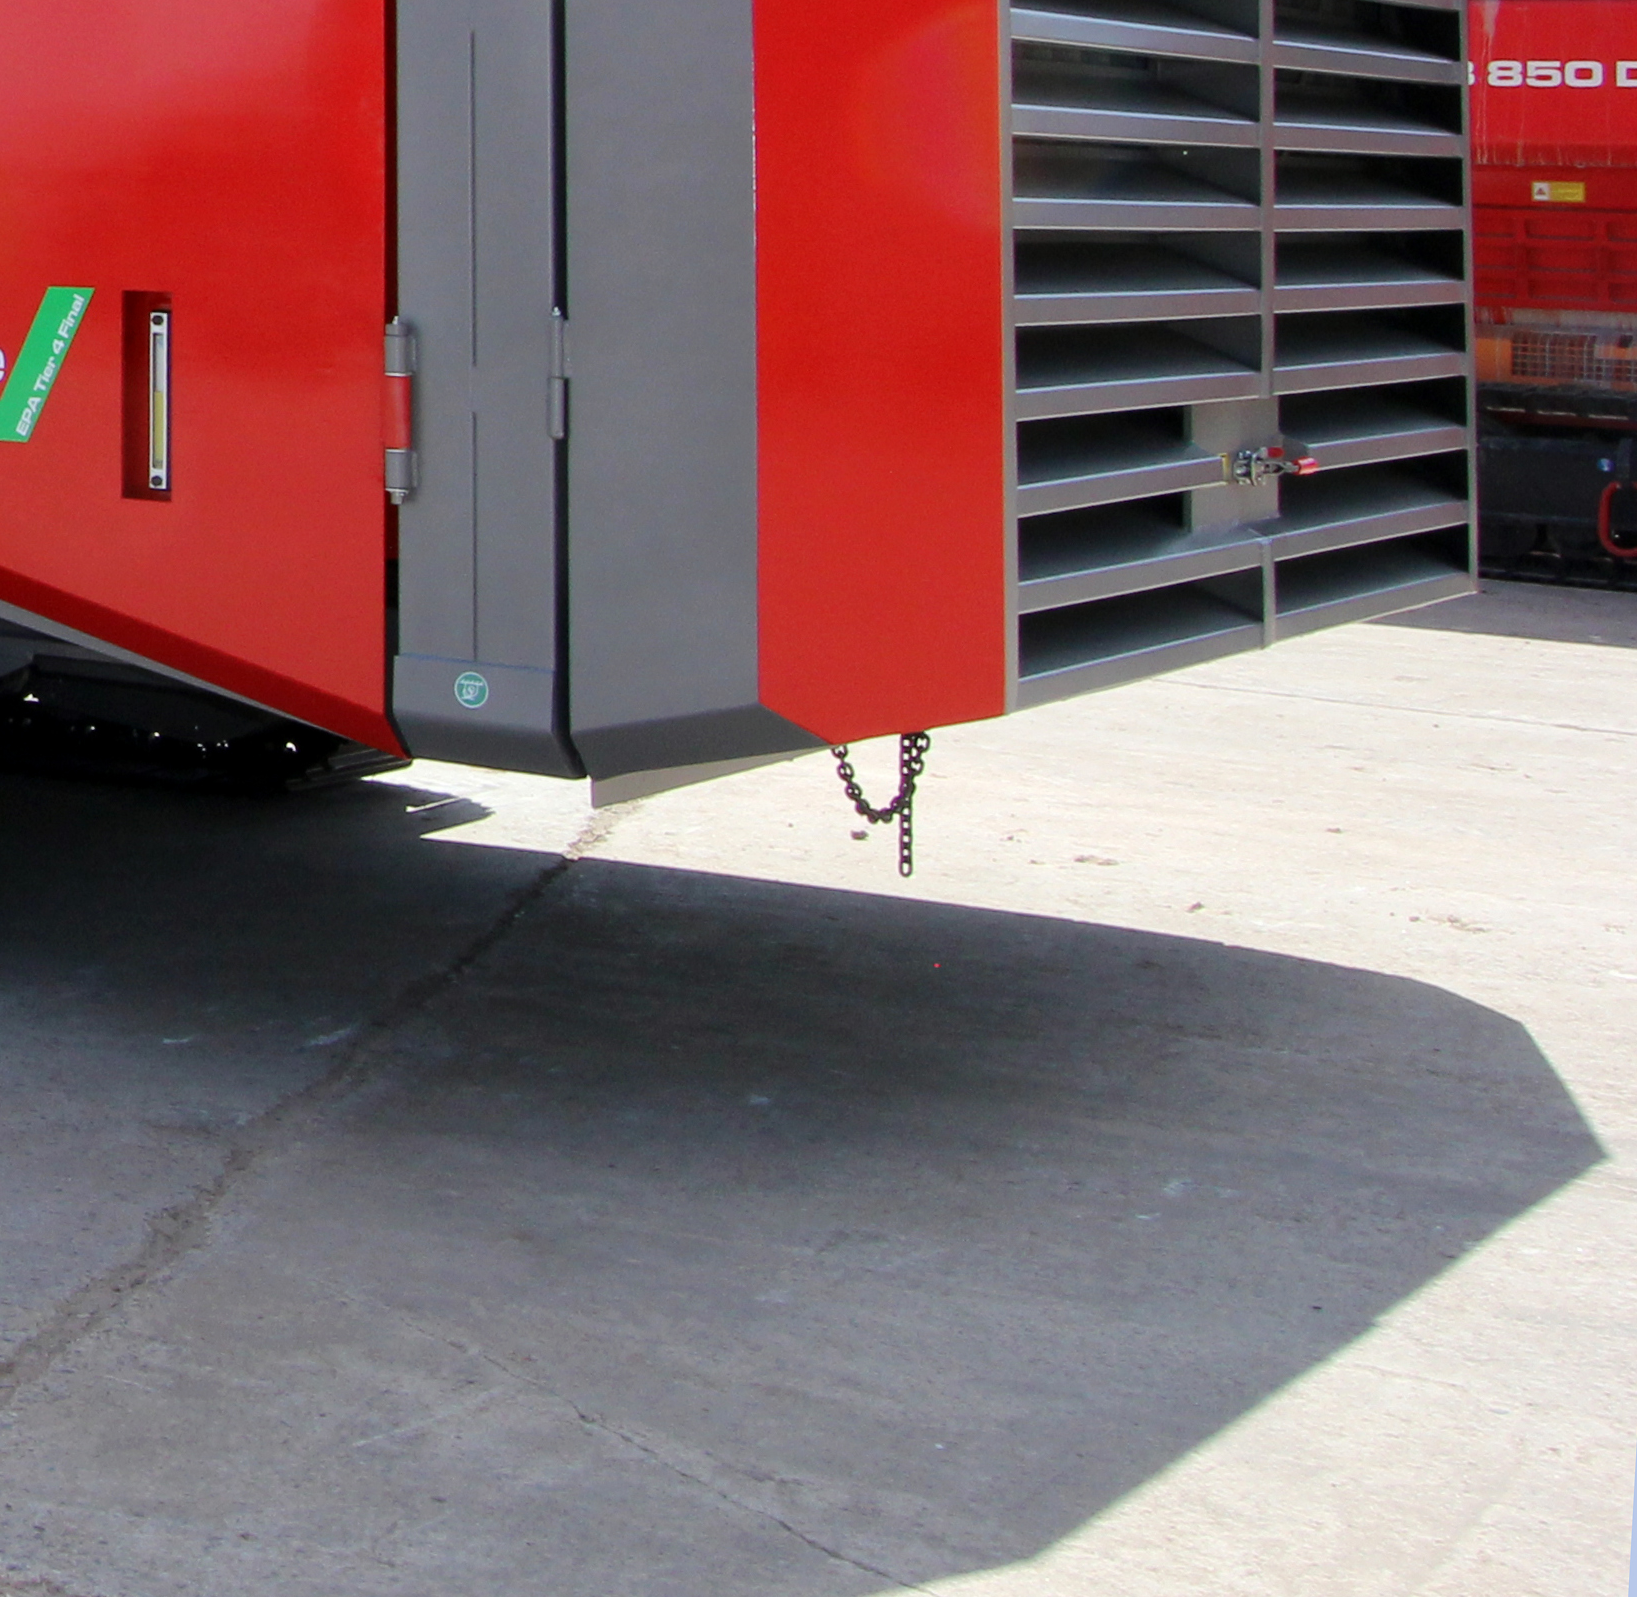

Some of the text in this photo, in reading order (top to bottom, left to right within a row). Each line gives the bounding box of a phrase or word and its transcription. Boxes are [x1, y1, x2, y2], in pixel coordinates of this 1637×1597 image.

[1487, 60, 1603, 88] 850
[15, 293, 86, 437] EPA Tier 4 Final
